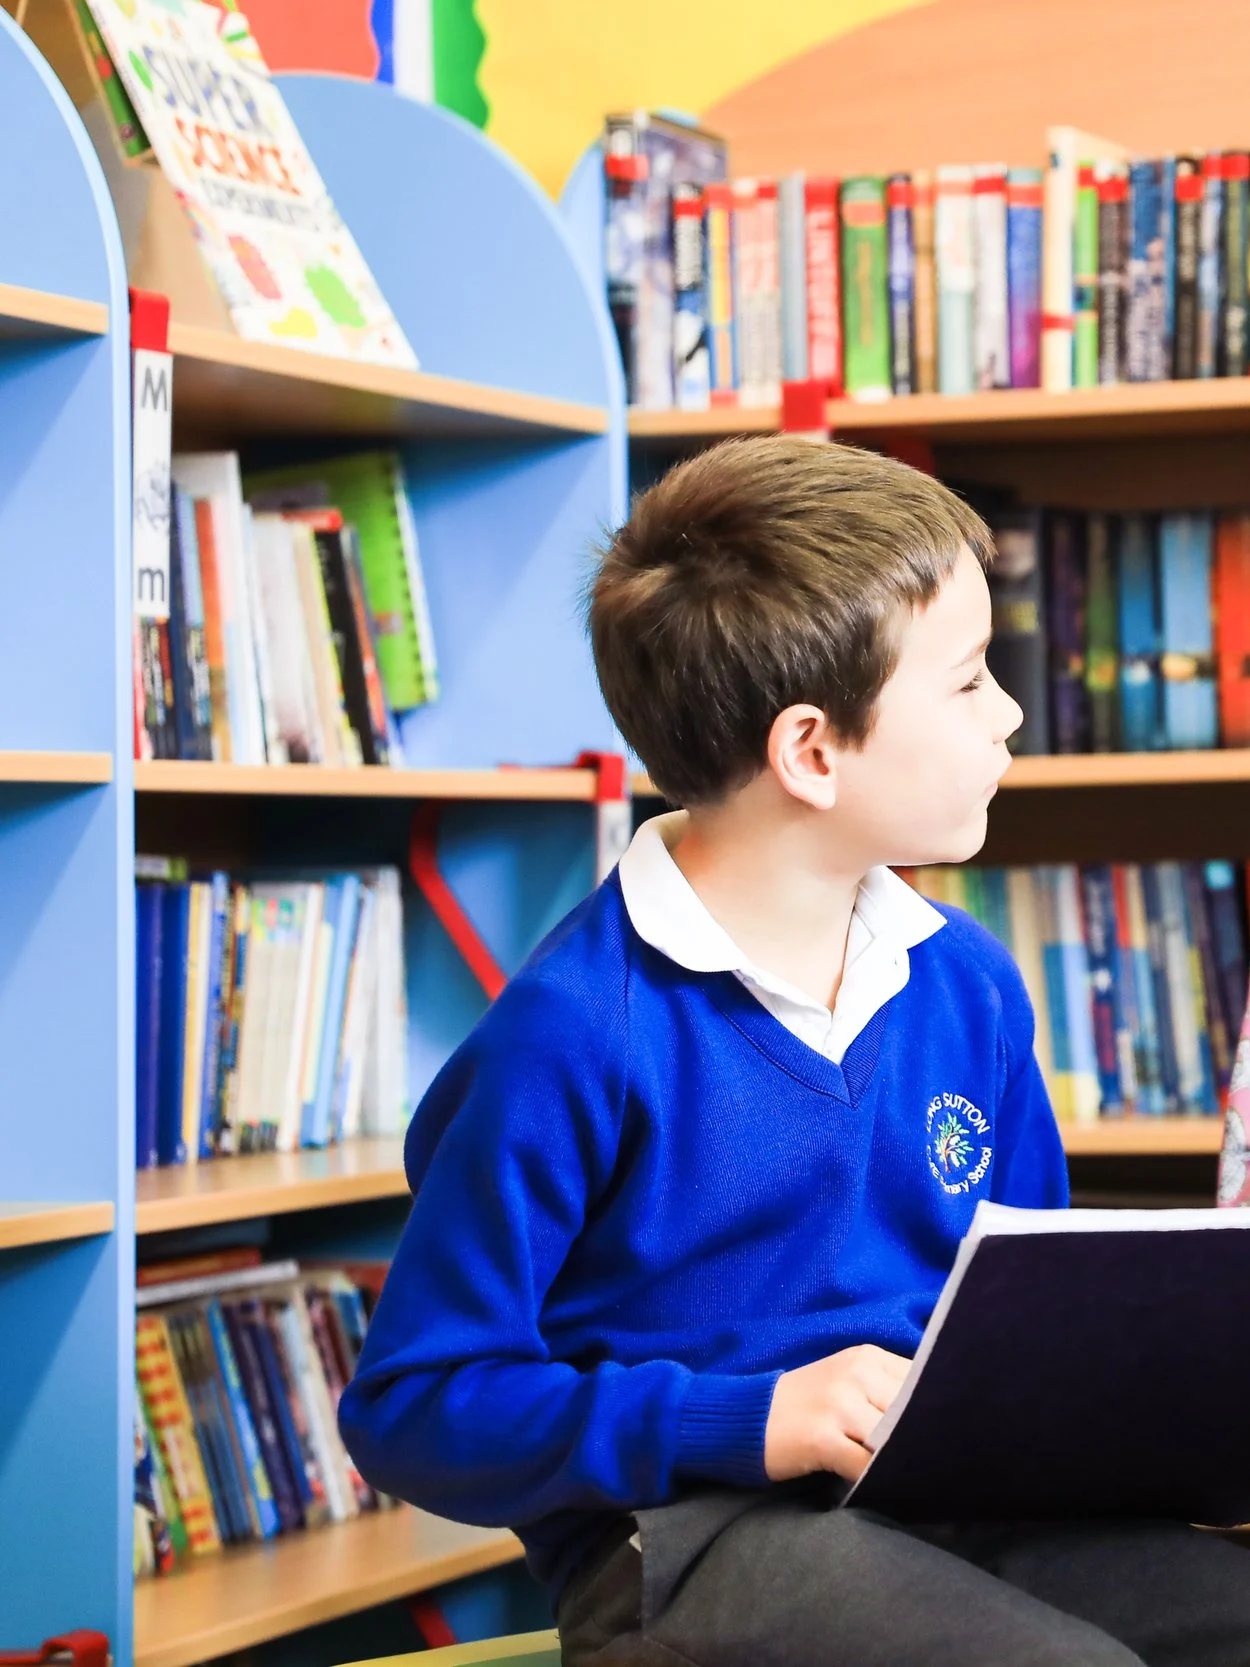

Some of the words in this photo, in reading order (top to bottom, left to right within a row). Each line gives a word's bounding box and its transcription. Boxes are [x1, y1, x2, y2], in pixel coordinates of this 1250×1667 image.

[141, 366, 168, 412] M
[138, 566, 165, 601] m
[943, 1092, 990, 1135] SUTTON
[968, 1146, 993, 1184] School
